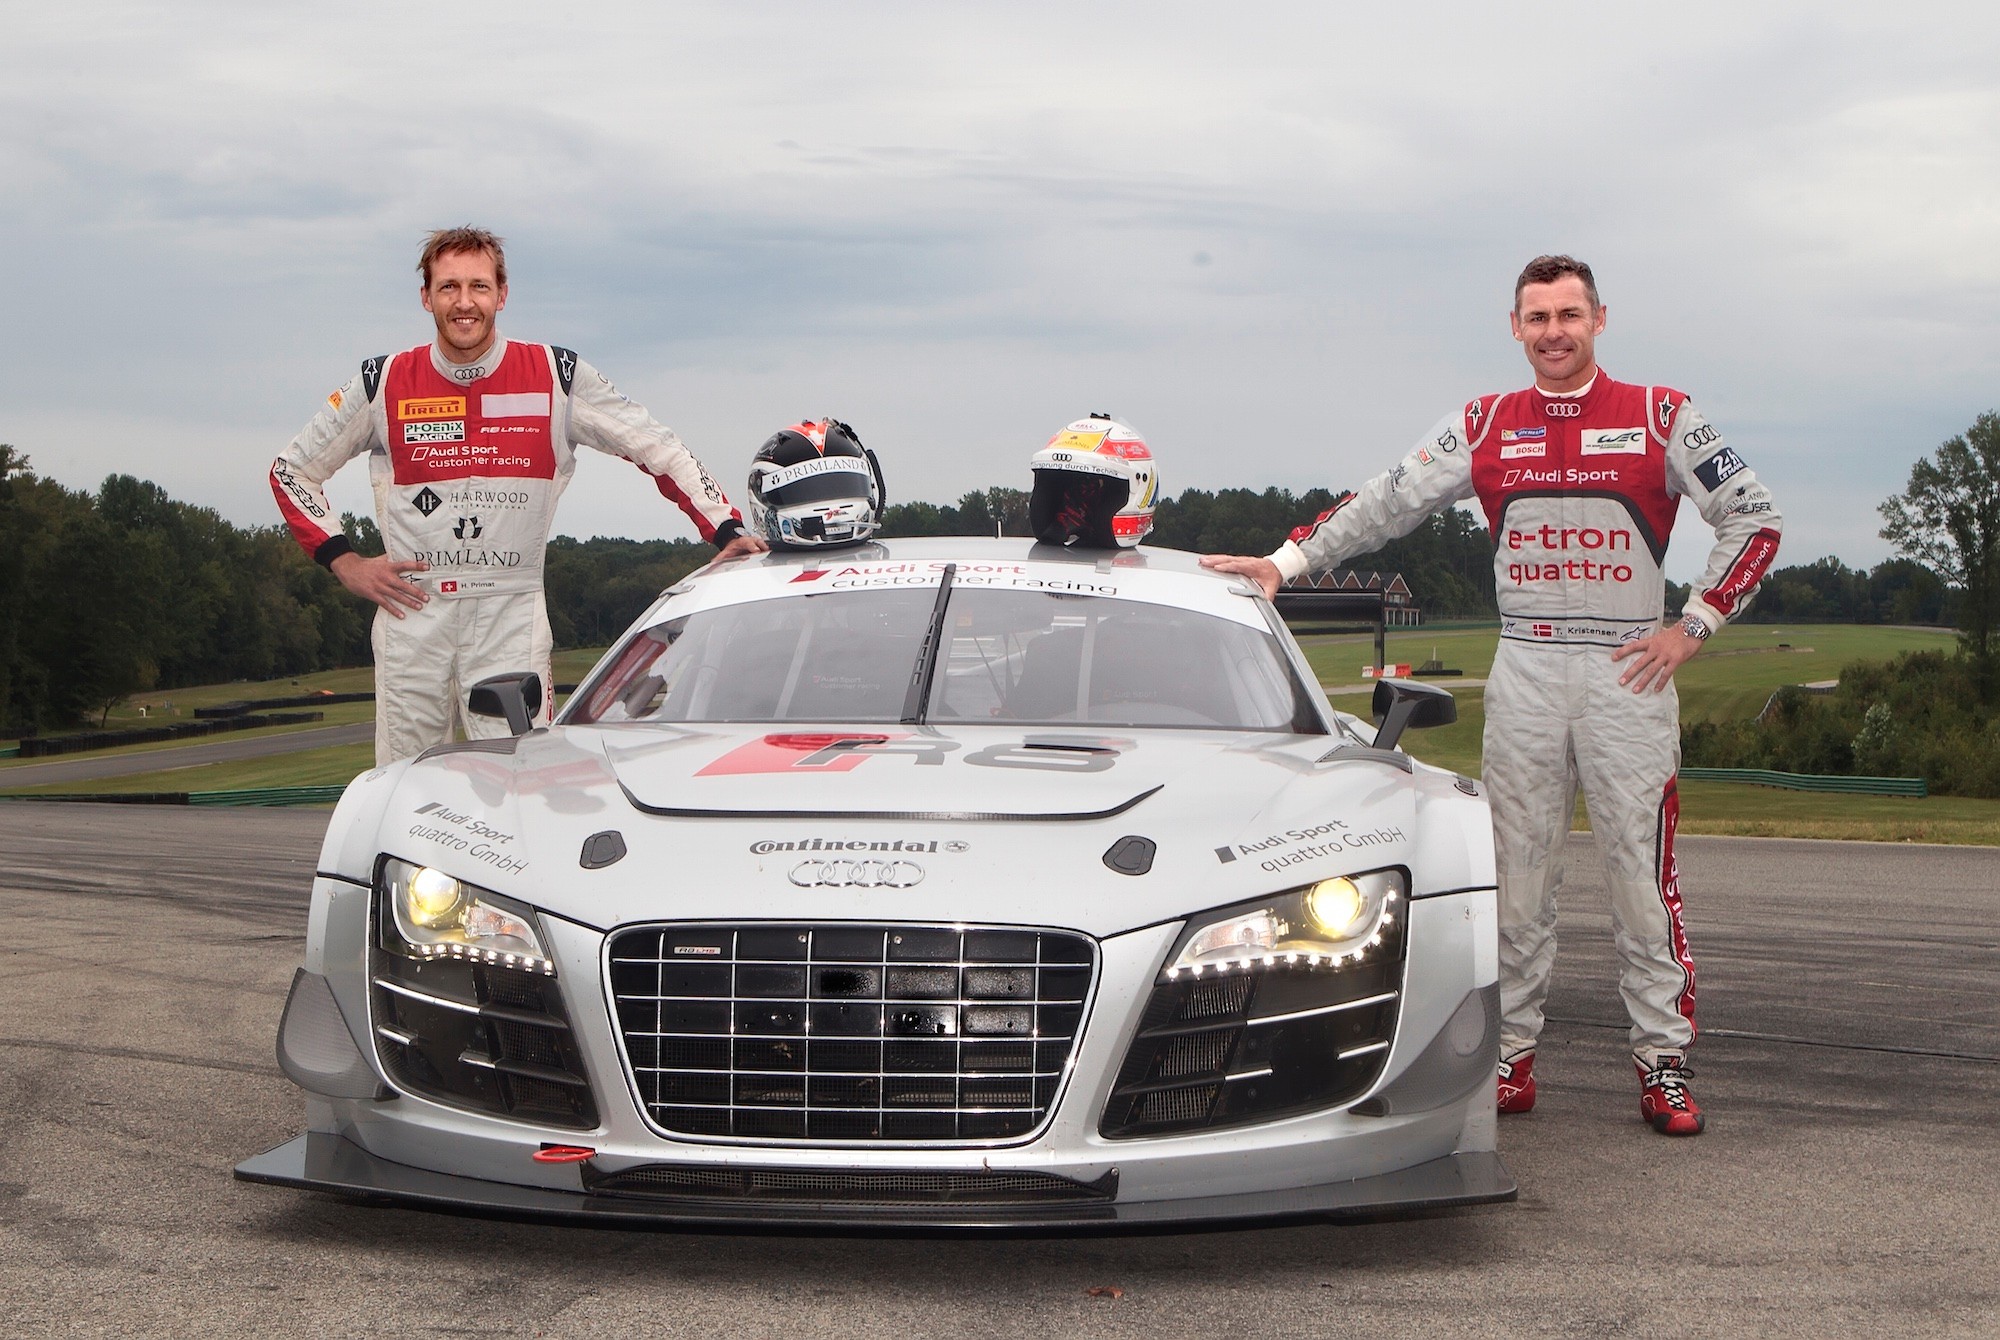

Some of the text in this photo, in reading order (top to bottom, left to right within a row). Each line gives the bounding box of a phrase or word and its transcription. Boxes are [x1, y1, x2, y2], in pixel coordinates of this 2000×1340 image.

[404, 400, 460, 416] PIRELLI
[1597, 432, 1643, 443] WEC
[429, 446, 498, 457] Audi Sport
[1516, 445, 1544, 455] BOSCH
[429, 456, 531, 468] customer racing
[784, 459, 860, 481] PRIMLAND
[1065, 463, 1090, 472] durch
[1522, 468, 1619, 485] Audi Sport
[449, 491, 529, 504] HARWOOD
[1723, 491, 1764, 514] PRIMLAND
[1508, 524, 1631, 551] e-tron
[413, 549, 521, 567] PRIMLAND
[836, 564, 916, 577] Audi
[1508, 559, 1632, 586] quattro
[1734, 541, 1771, 594] Audi Sport
[471, 581, 495, 589] Primat
[1012, 578, 1118, 596] racing
[1555, 626, 1617, 637] T. Kristensen
[794, 739, 1121, 773] R8
[432, 807, 515, 845] Audi Sport
[1237, 818, 1349, 856] Audi Sport
[409, 823, 529, 876] quattro GmbH
[749, 838, 938, 855] Continental
[1260, 826, 1407, 873] quattro GmbH
